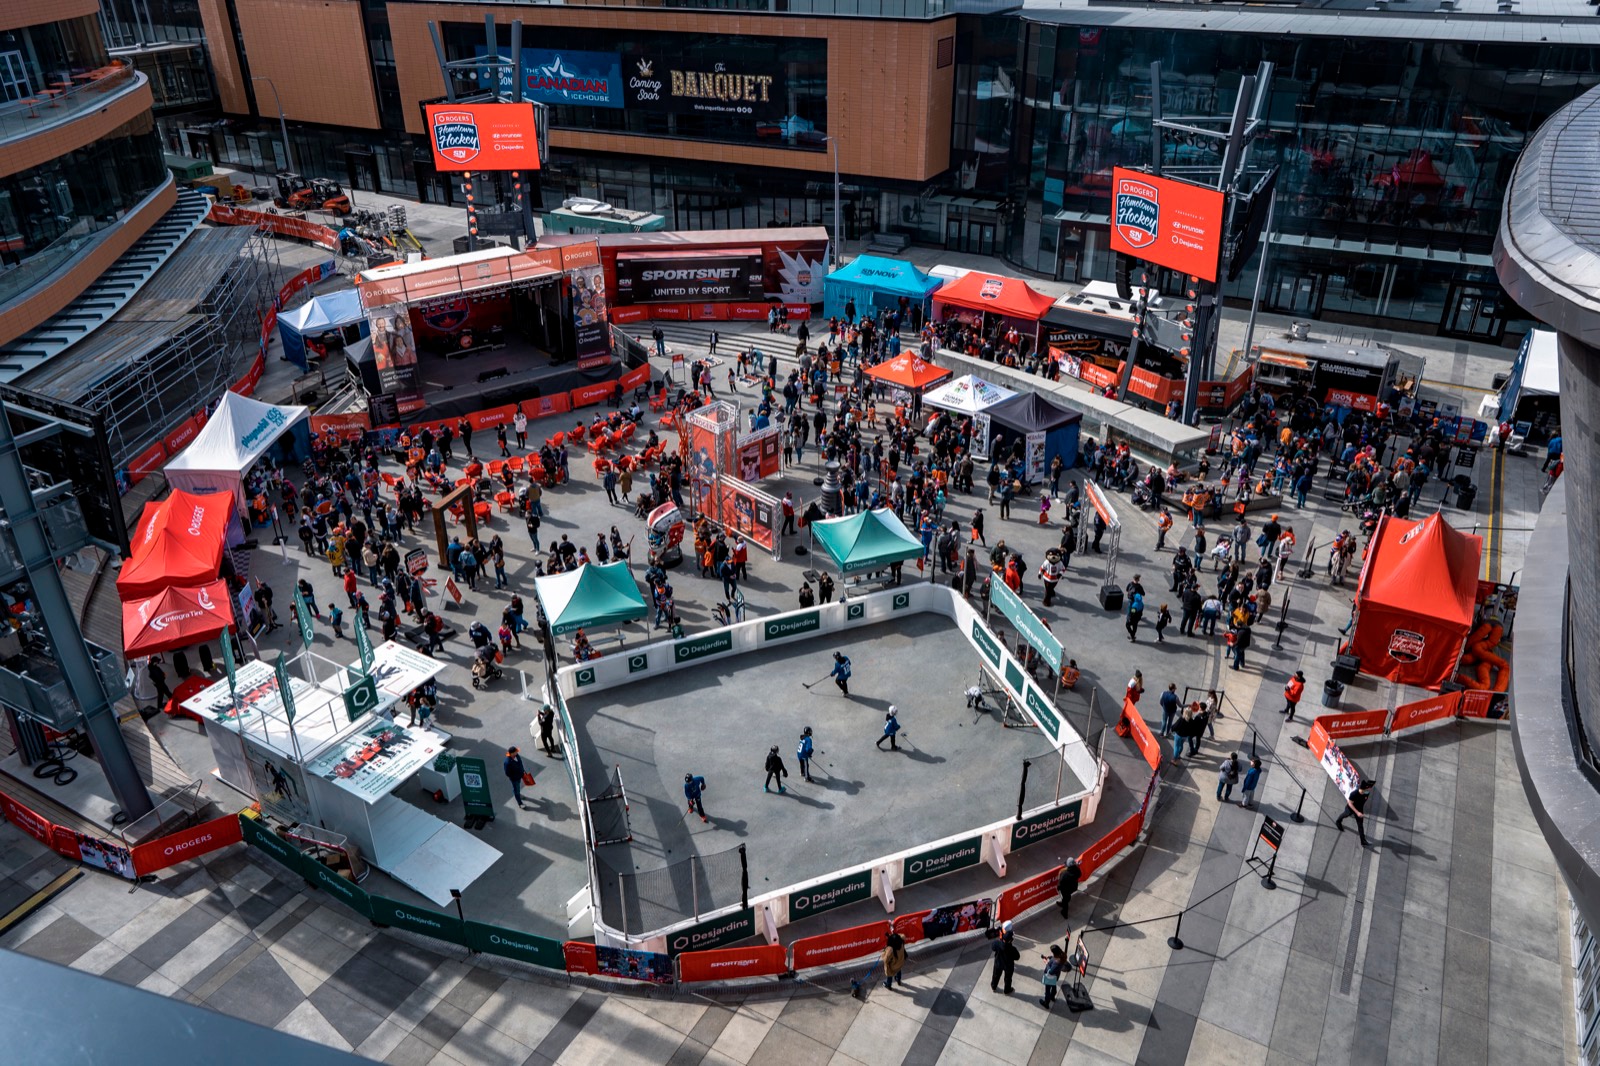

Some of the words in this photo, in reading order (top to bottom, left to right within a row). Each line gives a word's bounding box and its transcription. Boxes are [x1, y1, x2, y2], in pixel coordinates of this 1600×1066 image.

[527, 75, 607, 94] CANADIAN
[630, 76, 662, 92] Coming
[670, 70, 773, 102] BANQUET
[571, 94, 610, 102] ICEHOUSE
[637, 88, 660, 101] Soon
[438, 125, 475, 135] Hometown
[438, 133, 478, 151] Hockey
[1130, 186, 1154, 198] ROGERS
[1120, 196, 1156, 215] Hometown
[1118, 208, 1157, 236] Hockey
[1179, 238, 1204, 251] Desjardins
[570, 250, 592, 260] ROGERS
[414, 274, 464, 288] #hometownhockey
[642, 267, 740, 282] SPORTSNET
[876, 271, 898, 279] NOW
[373, 286, 400, 297] ROGERS
[654, 287, 686, 296] UNITED
[688, 287, 700, 295] BY
[701, 286, 731, 295] SPORT
[944, 394, 964, 402] HUMANE
[1332, 392, 1352, 400] 100%
[486, 414, 505, 422] ROGERS
[695, 418, 716, 433] ROGERS
[176, 427, 192, 444] ROGERS
[194, 505, 204, 529] ROGERS
[852, 558, 877, 568] Desjardins
[165, 612, 190, 623] Integra
[780, 618, 816, 632] Desjardins
[564, 620, 592, 631] Desjardins
[691, 638, 728, 654] Desjardins
[1014, 614, 1047, 653] Community
[1046, 646, 1058, 666] Cup
[979, 634, 999, 662] Desjardins
[1034, 700, 1057, 732] Desjardins
[1418, 704, 1444, 716] Desjardins
[1030, 810, 1075, 832] Desjardins
[1030, 828, 1044, 838] Wealth
[1045, 818, 1076, 834] Management
[175, 834, 212, 852] ROGERS
[924, 846, 976, 868] Desjardins
[924, 862, 950, 874] Insurance
[812, 880, 866, 904] Desjardins
[1023, 878, 1052, 896] FOLLOW
[812, 898, 836, 910] Business
[406, 912, 441, 928] Desjardins
[692, 918, 749, 944] Desjardins
[502, 938, 540, 953] Desjardins
[692, 936, 720, 950] Insurance
[806, 936, 881, 956] #hometownhockey
[710, 958, 760, 968] SPORTSNET
